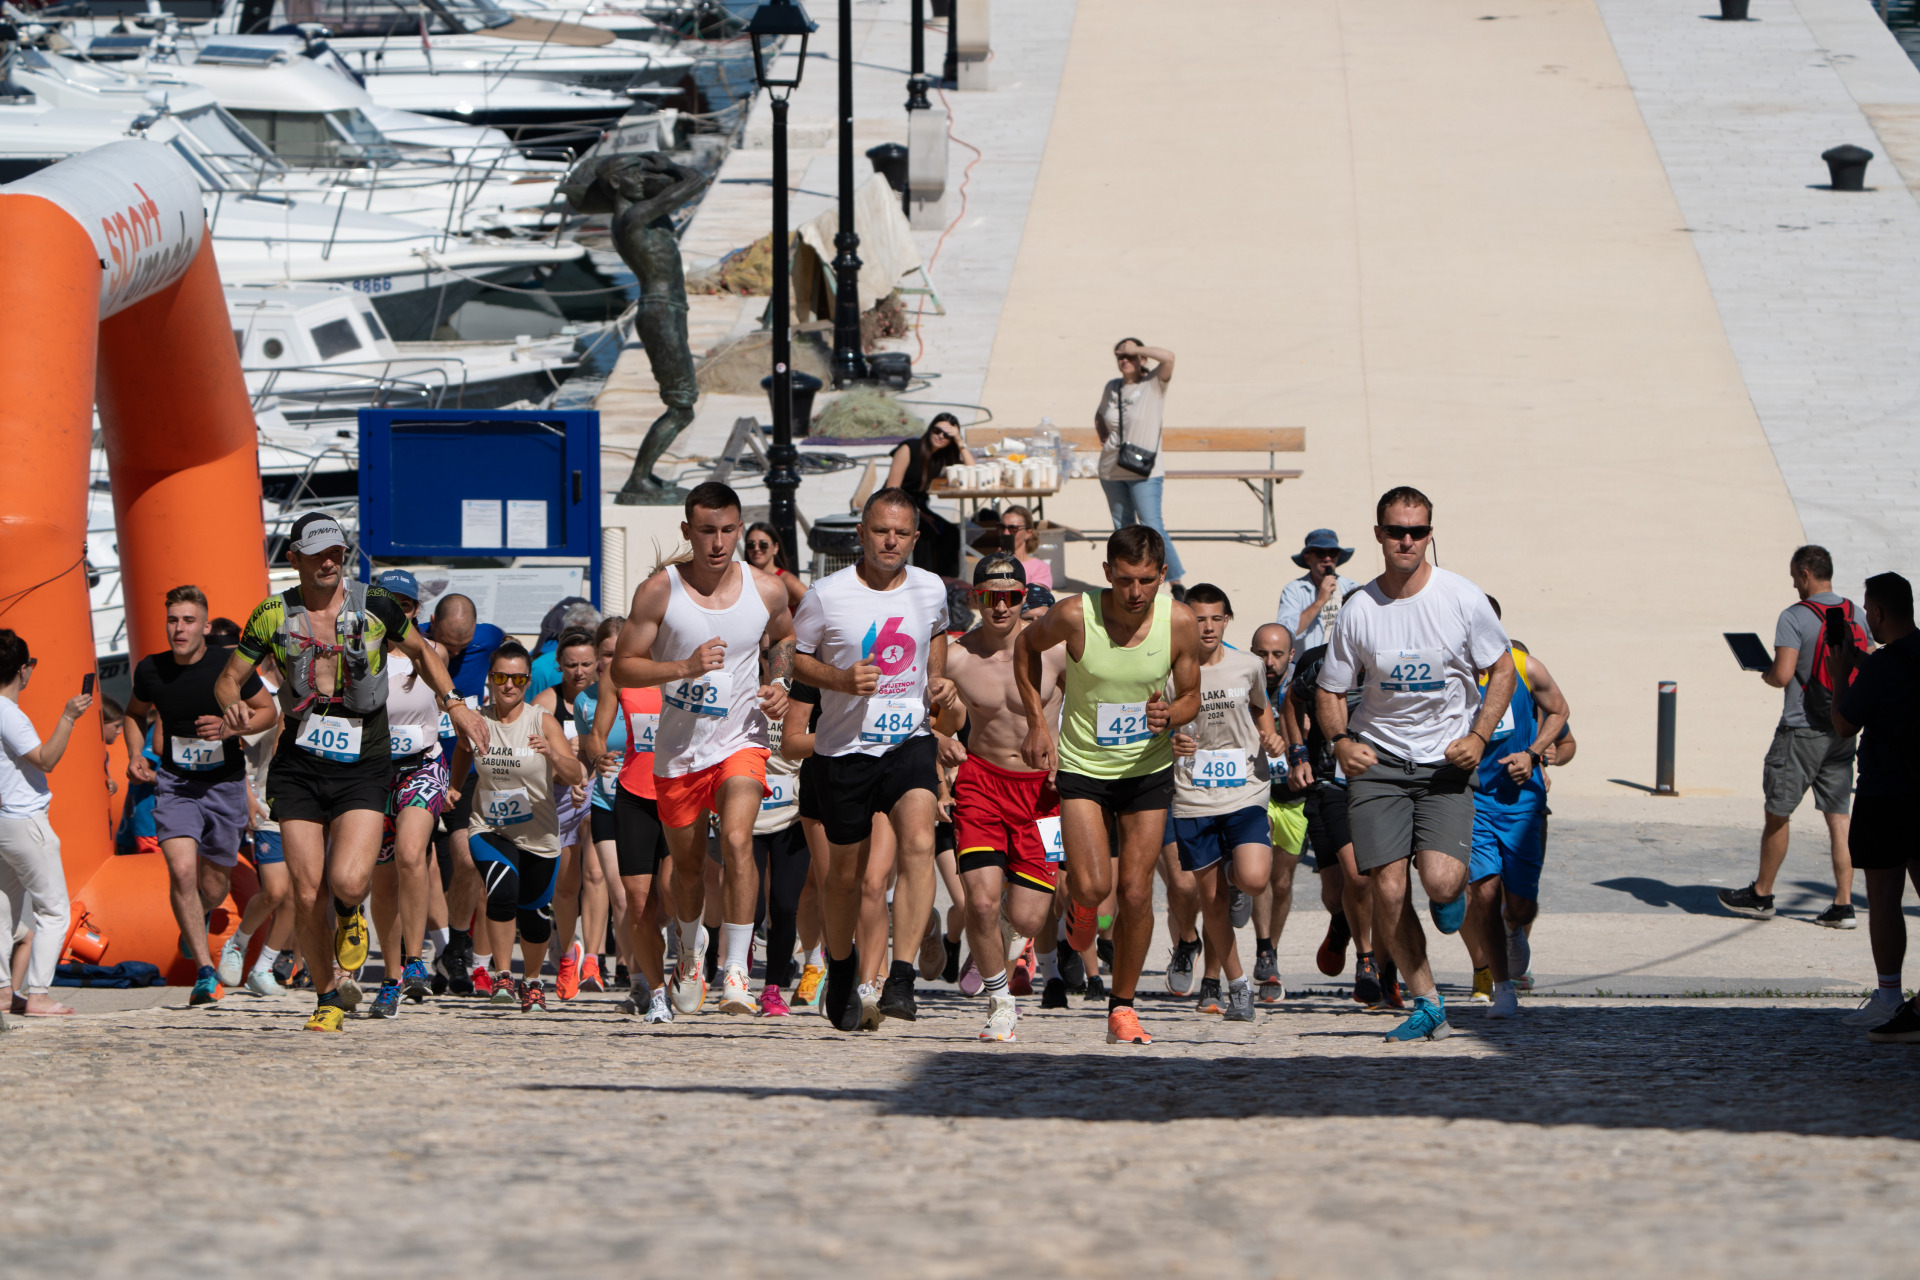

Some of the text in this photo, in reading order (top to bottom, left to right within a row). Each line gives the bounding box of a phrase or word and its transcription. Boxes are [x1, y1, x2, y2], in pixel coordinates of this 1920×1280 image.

[308, 527, 339, 538] DYNAFIT
[366, 587, 389, 597] AST
[257, 601, 283, 616] LIGHT
[1390, 663, 1432, 681] 422
[676, 682, 718, 704] 493
[1201, 688, 1246, 700] LAKA RUN
[1200, 701, 1235, 712] ABUNING
[874, 713, 913, 732] 484
[1207, 711, 1224, 719] 2024
[1109, 714, 1147, 734] 421
[307, 729, 349, 750] 405
[390, 737, 412, 752] 83
[182, 748, 213, 762] 417
[515, 747, 534, 757] RUN
[481, 757, 521, 767] SABUNING
[1202, 761, 1236, 777] 480
[1269, 761, 1286, 776] 48
[489, 800, 522, 817] 492
